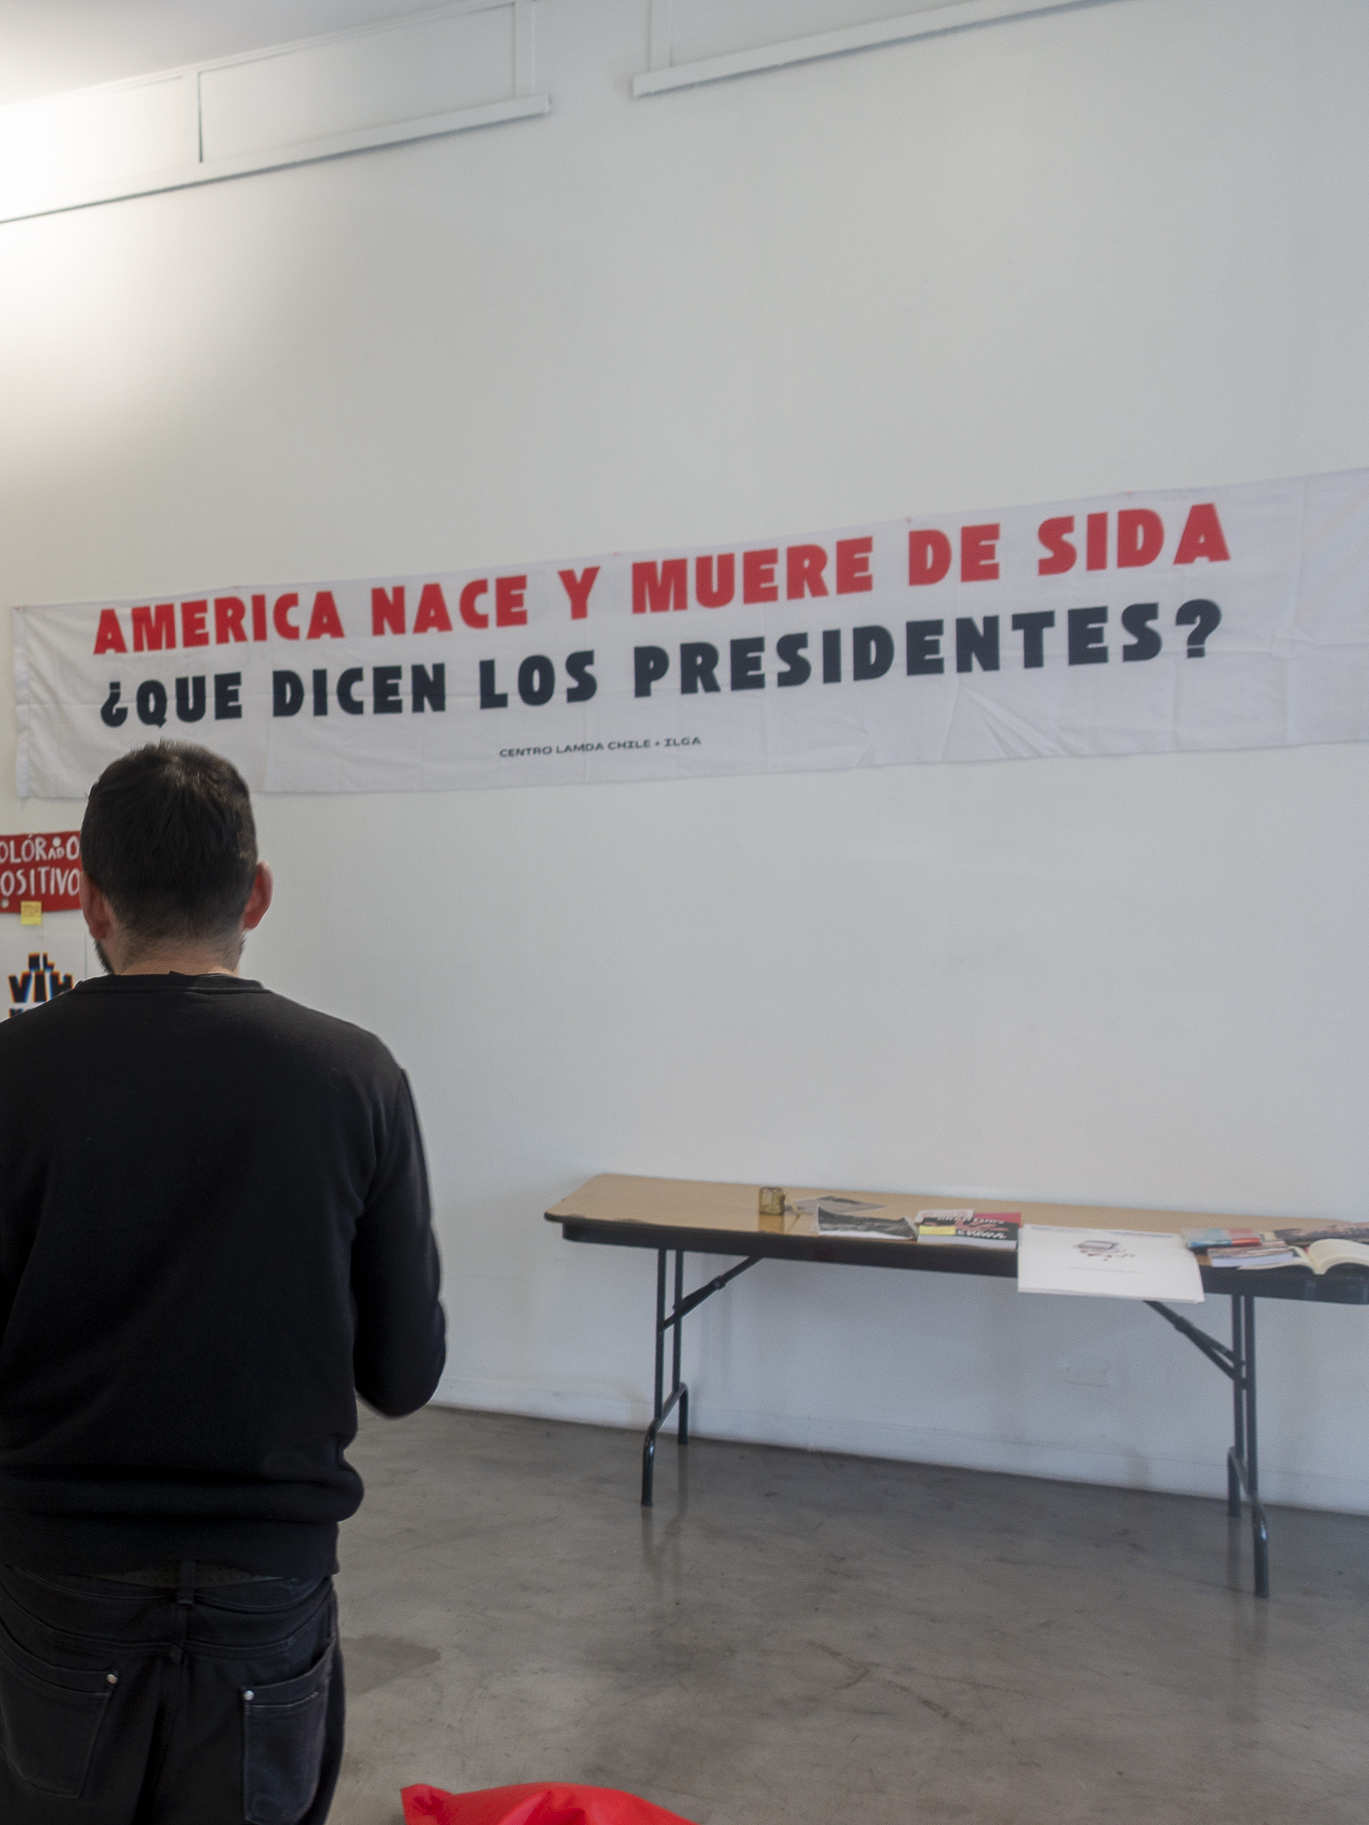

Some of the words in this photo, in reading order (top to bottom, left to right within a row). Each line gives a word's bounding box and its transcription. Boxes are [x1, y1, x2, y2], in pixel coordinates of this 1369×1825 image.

[93, 591, 345, 655] AMERICA
[371, 575, 528, 637] NACE
[558, 566, 601, 619] Y
[631, 536, 873, 614] MUERE
[908, 523, 1000, 586] DE
[1038, 502, 1231, 576] SIDA
[100, 672, 242, 728] ¿QUE
[272, 663, 446, 717] DICEN
[479, 650, 598, 710] LOS
[633, 599, 1222, 698] PRESIDENTES?
[499, 746, 553, 758] CENTRO
[556, 742, 604, 754] LAMDA
[607, 739, 651, 750] CHILE
[664, 736, 702, 746] ILGA
